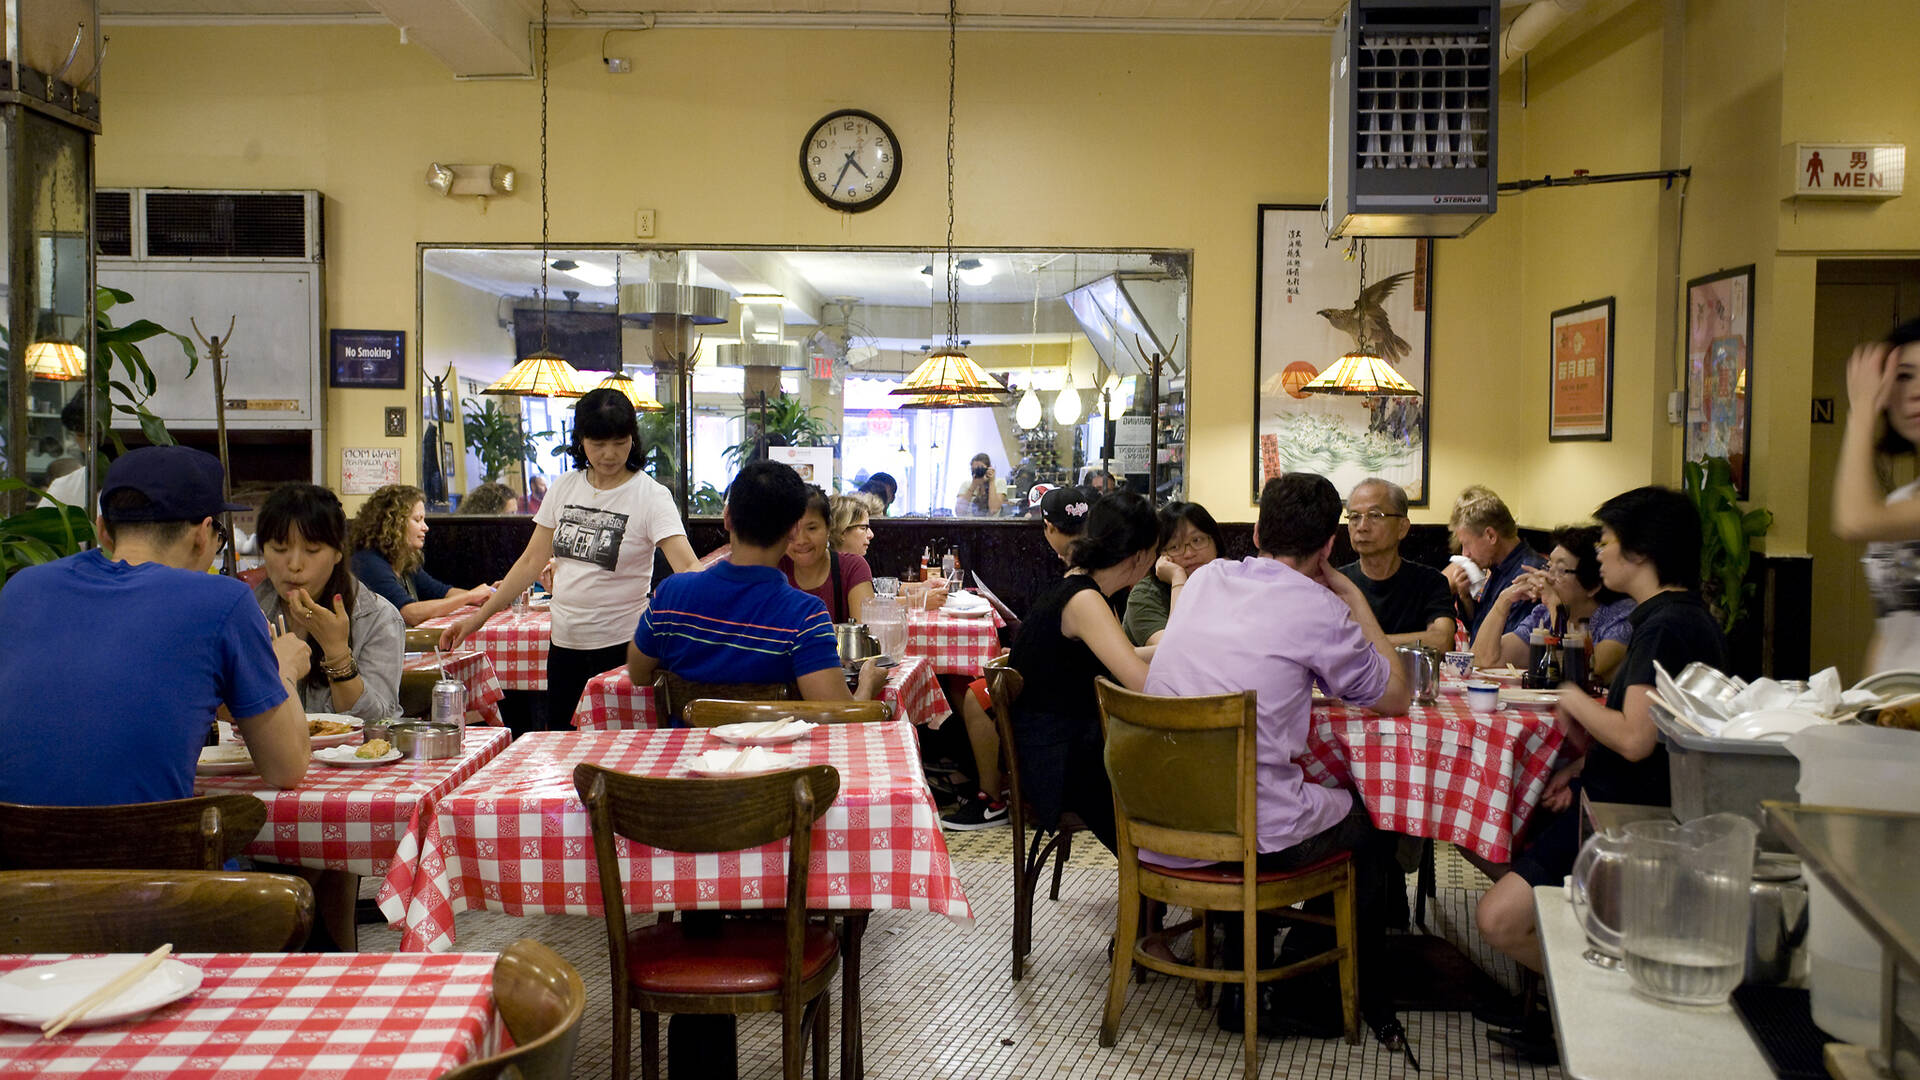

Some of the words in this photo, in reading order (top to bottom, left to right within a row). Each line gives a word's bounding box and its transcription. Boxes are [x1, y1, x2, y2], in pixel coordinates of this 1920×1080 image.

[829, 126, 836, 136] 11
[844, 121, 854, 131] 12
[816, 139, 827, 149] 10
[875, 137, 884, 147] 2
[812, 156, 821, 165] 9
[881, 153, 889, 163] 3
[1850, 151, 1867, 169] 男
[818, 172, 826, 182] 8
[876, 171, 884, 179] 4
[1833, 172, 1884, 187] MEN
[847, 187, 856, 197] 6
[865, 183, 873, 192] 5
[345, 347, 357, 358] No
[357, 346, 392, 359] Smoking
